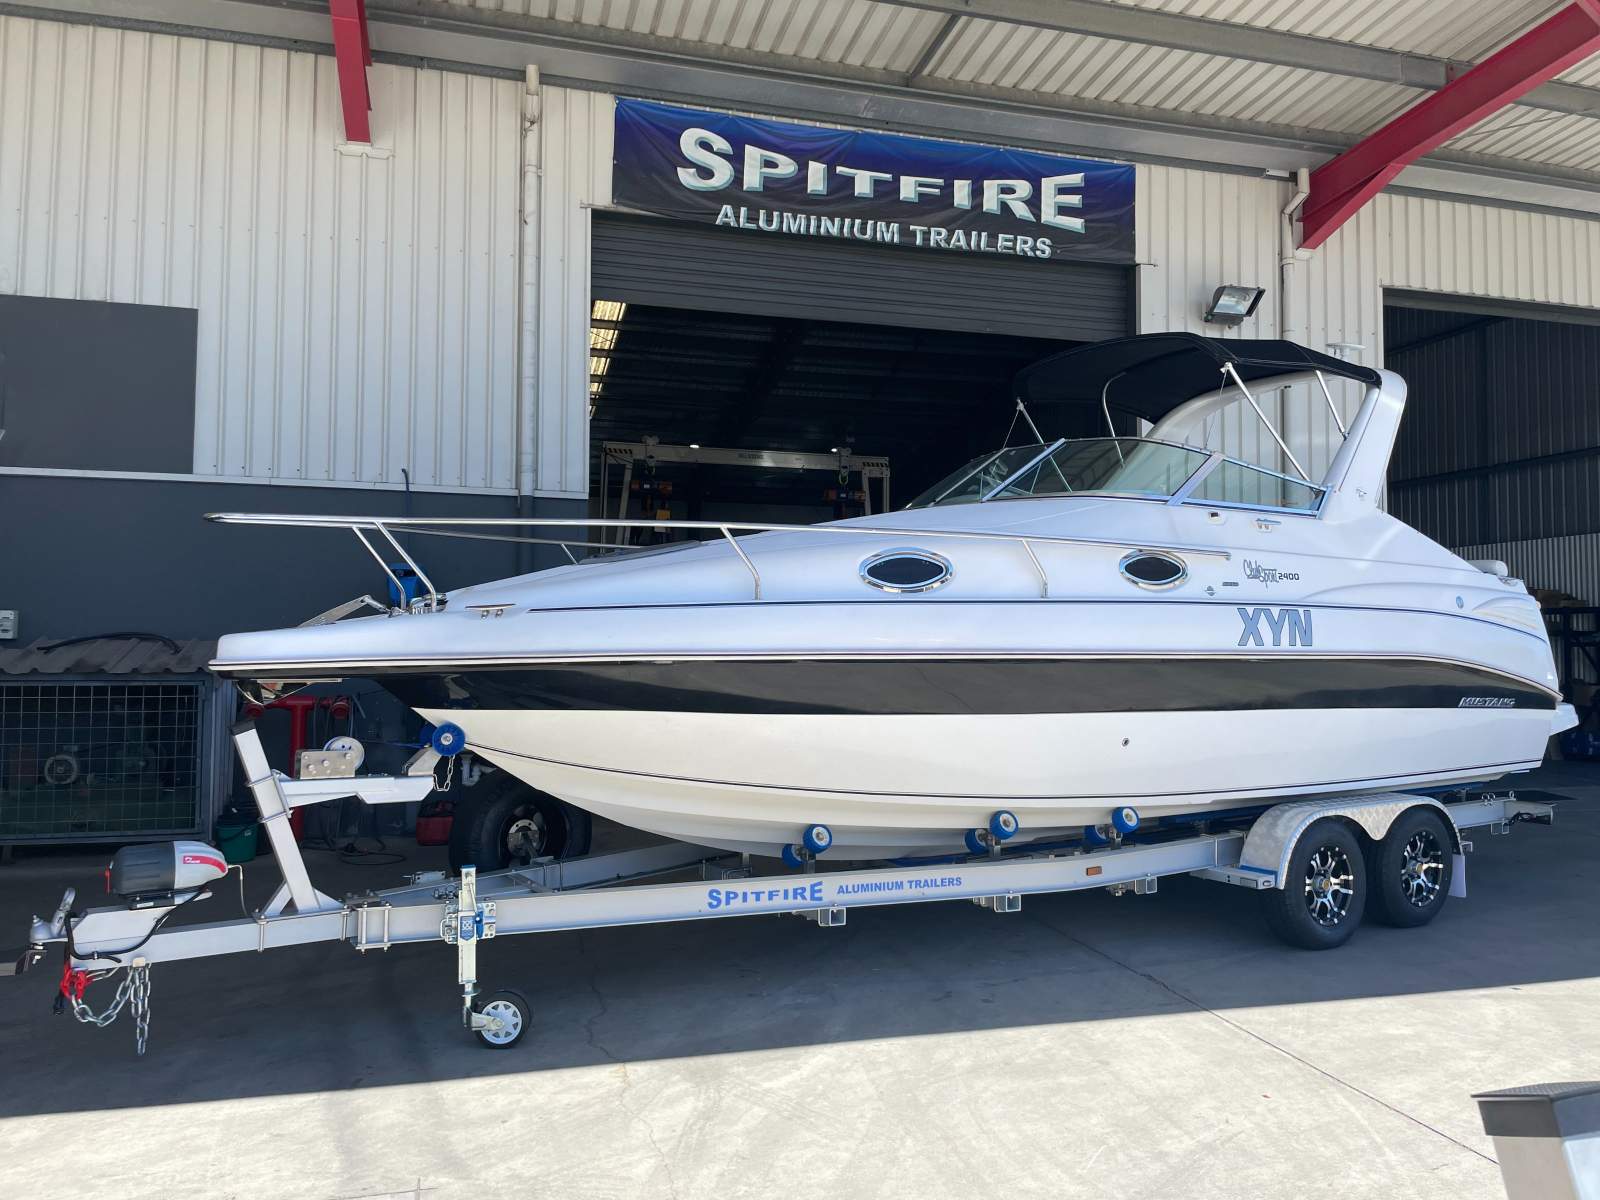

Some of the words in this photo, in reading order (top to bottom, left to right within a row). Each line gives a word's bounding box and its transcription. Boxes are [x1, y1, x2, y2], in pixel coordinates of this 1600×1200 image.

[676, 127, 1086, 234] SPITFIRE
[715, 203, 900, 244] ALUMINIUM
[909, 224, 1053, 260] TRAILERS
[1278, 572, 1300, 580] 2400
[1237, 607, 1313, 647] XYN
[1458, 697, 1516, 708] MUSTANG
[707, 881, 823, 910] SPITFIRE
[837, 880, 904, 895] ALUMINIUM
[907, 876, 962, 890] TRAILERS
